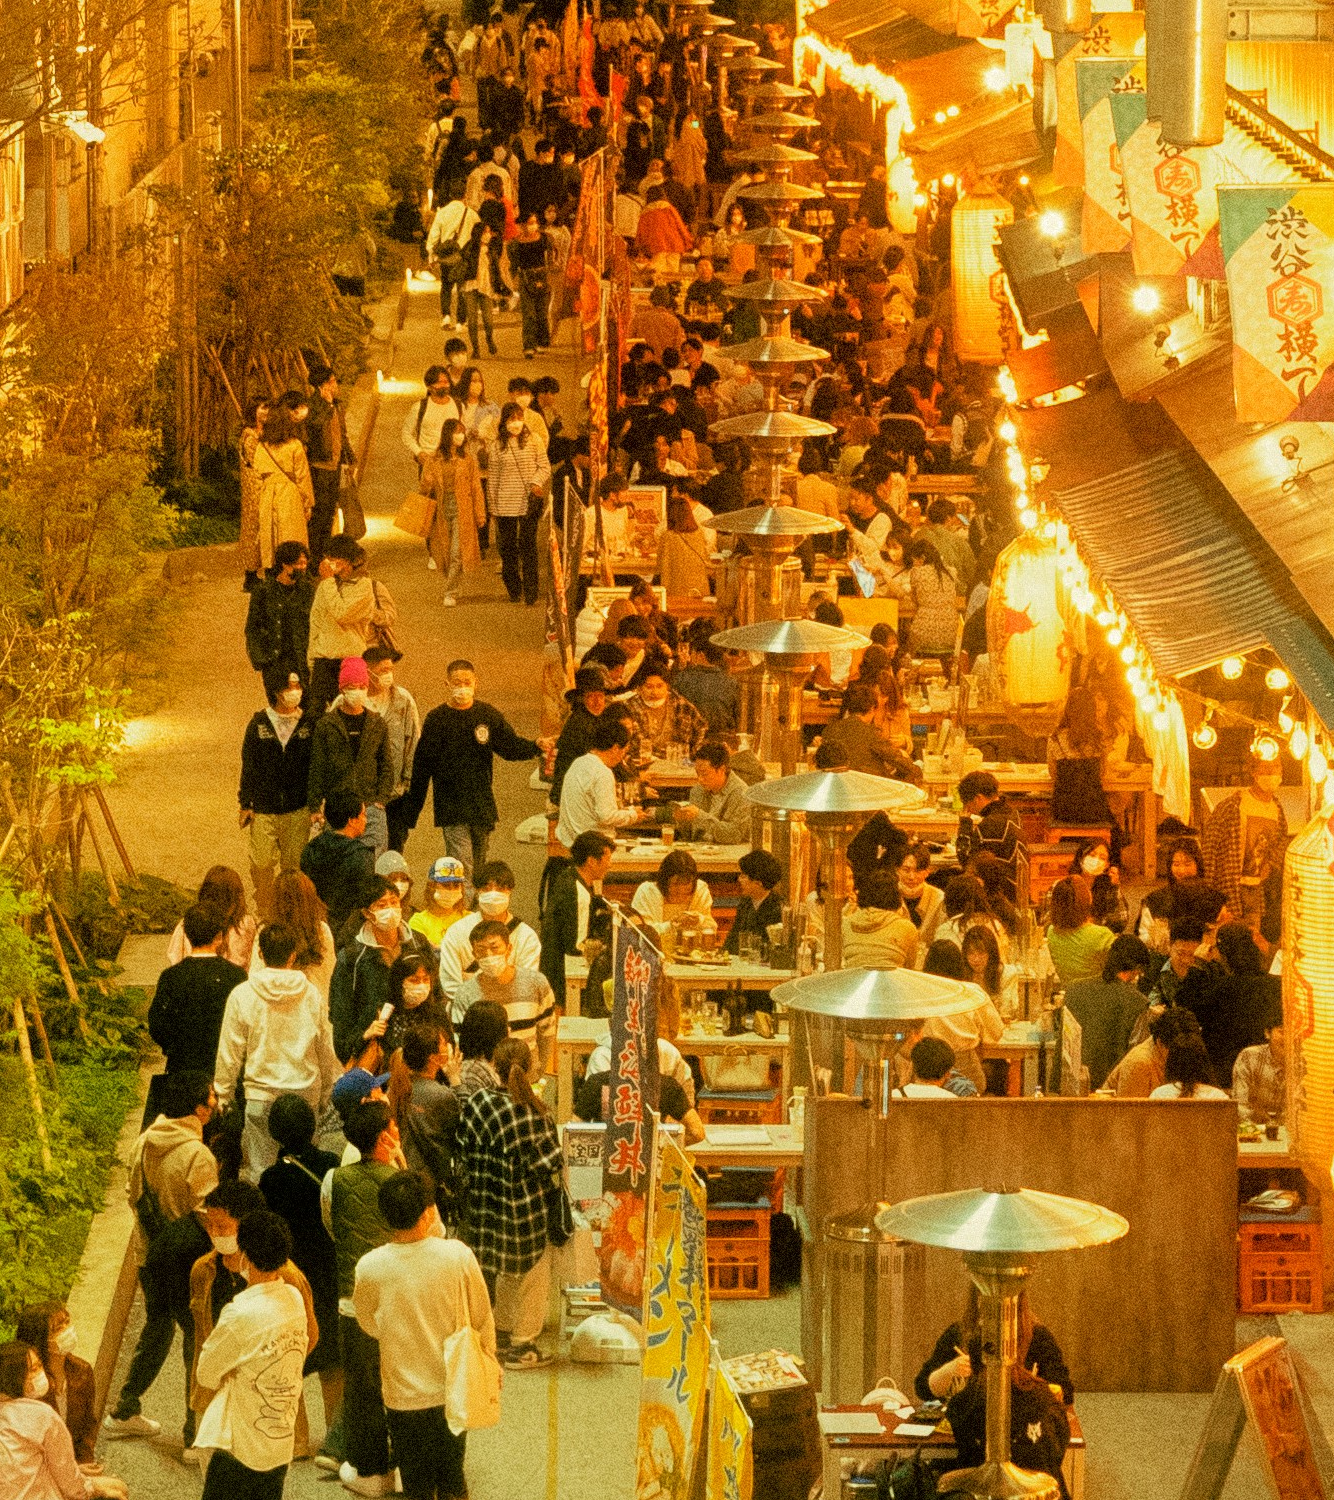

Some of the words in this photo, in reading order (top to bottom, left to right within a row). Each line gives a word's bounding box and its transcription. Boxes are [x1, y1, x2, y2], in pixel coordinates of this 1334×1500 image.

[1264, 206, 1324, 406] 渋谷寿横丁
